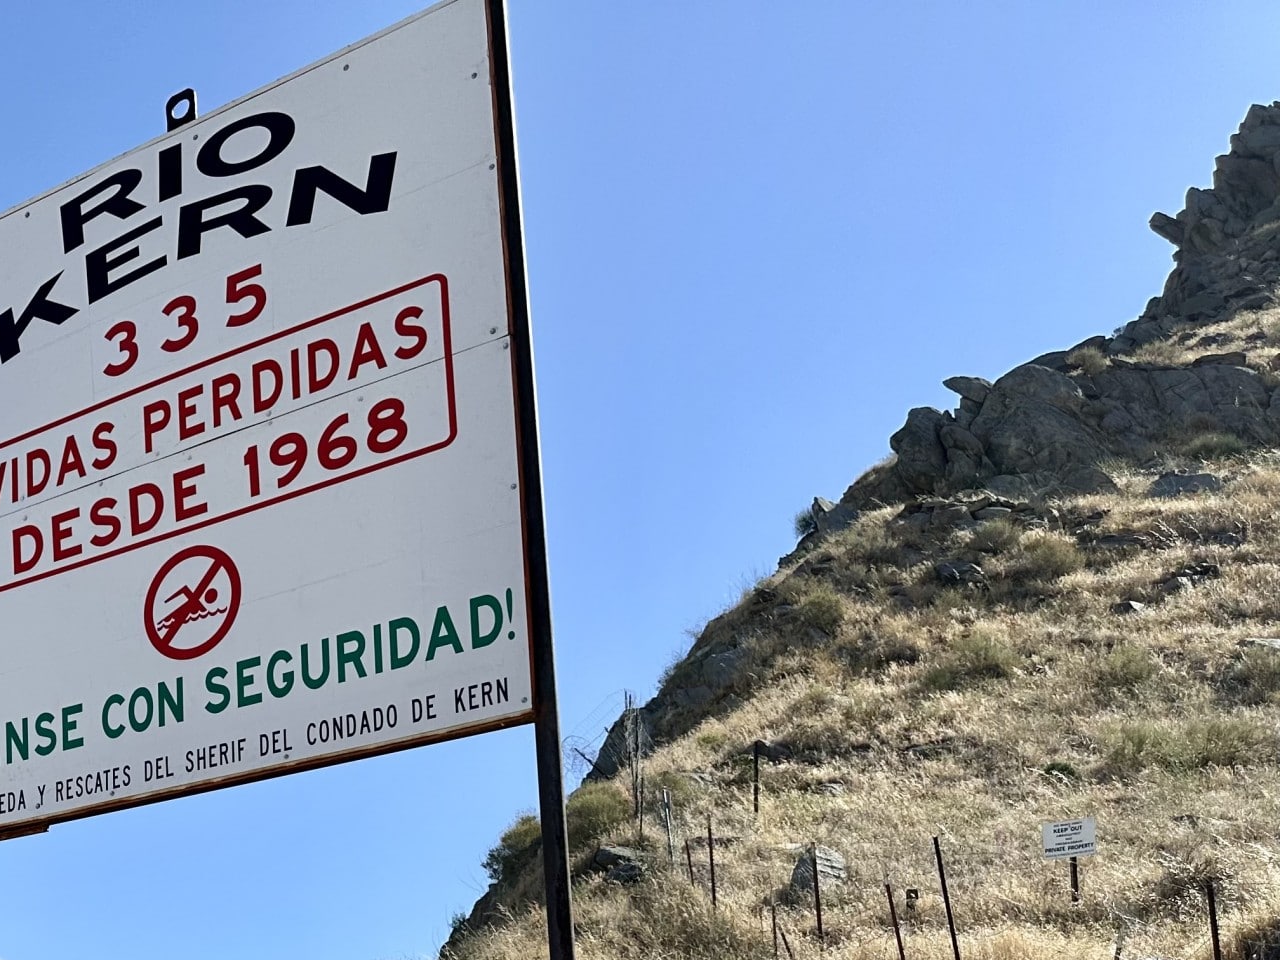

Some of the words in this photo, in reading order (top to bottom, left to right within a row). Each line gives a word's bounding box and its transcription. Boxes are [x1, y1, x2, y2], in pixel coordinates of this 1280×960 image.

[60, 112, 296, 254] RIO
[142, 305, 428, 453] PERDIDAS
[12, 463, 208, 576] DESDE
[243, 397, 409, 498] 1968
[101, 676, 184, 739] CON
[204, 587, 517, 714] SEGURIDAD!
[37, 784, 46, 806] Y
[56, 765, 132, 803] RESCATES
[144, 756, 174, 782] DEL
[185, 738, 247, 773] SHERIF
[259, 728, 293, 757] DEL
[306, 704, 399, 746] CONDADO
[412, 694, 437, 723] DE
[454, 677, 510, 714] KERN
